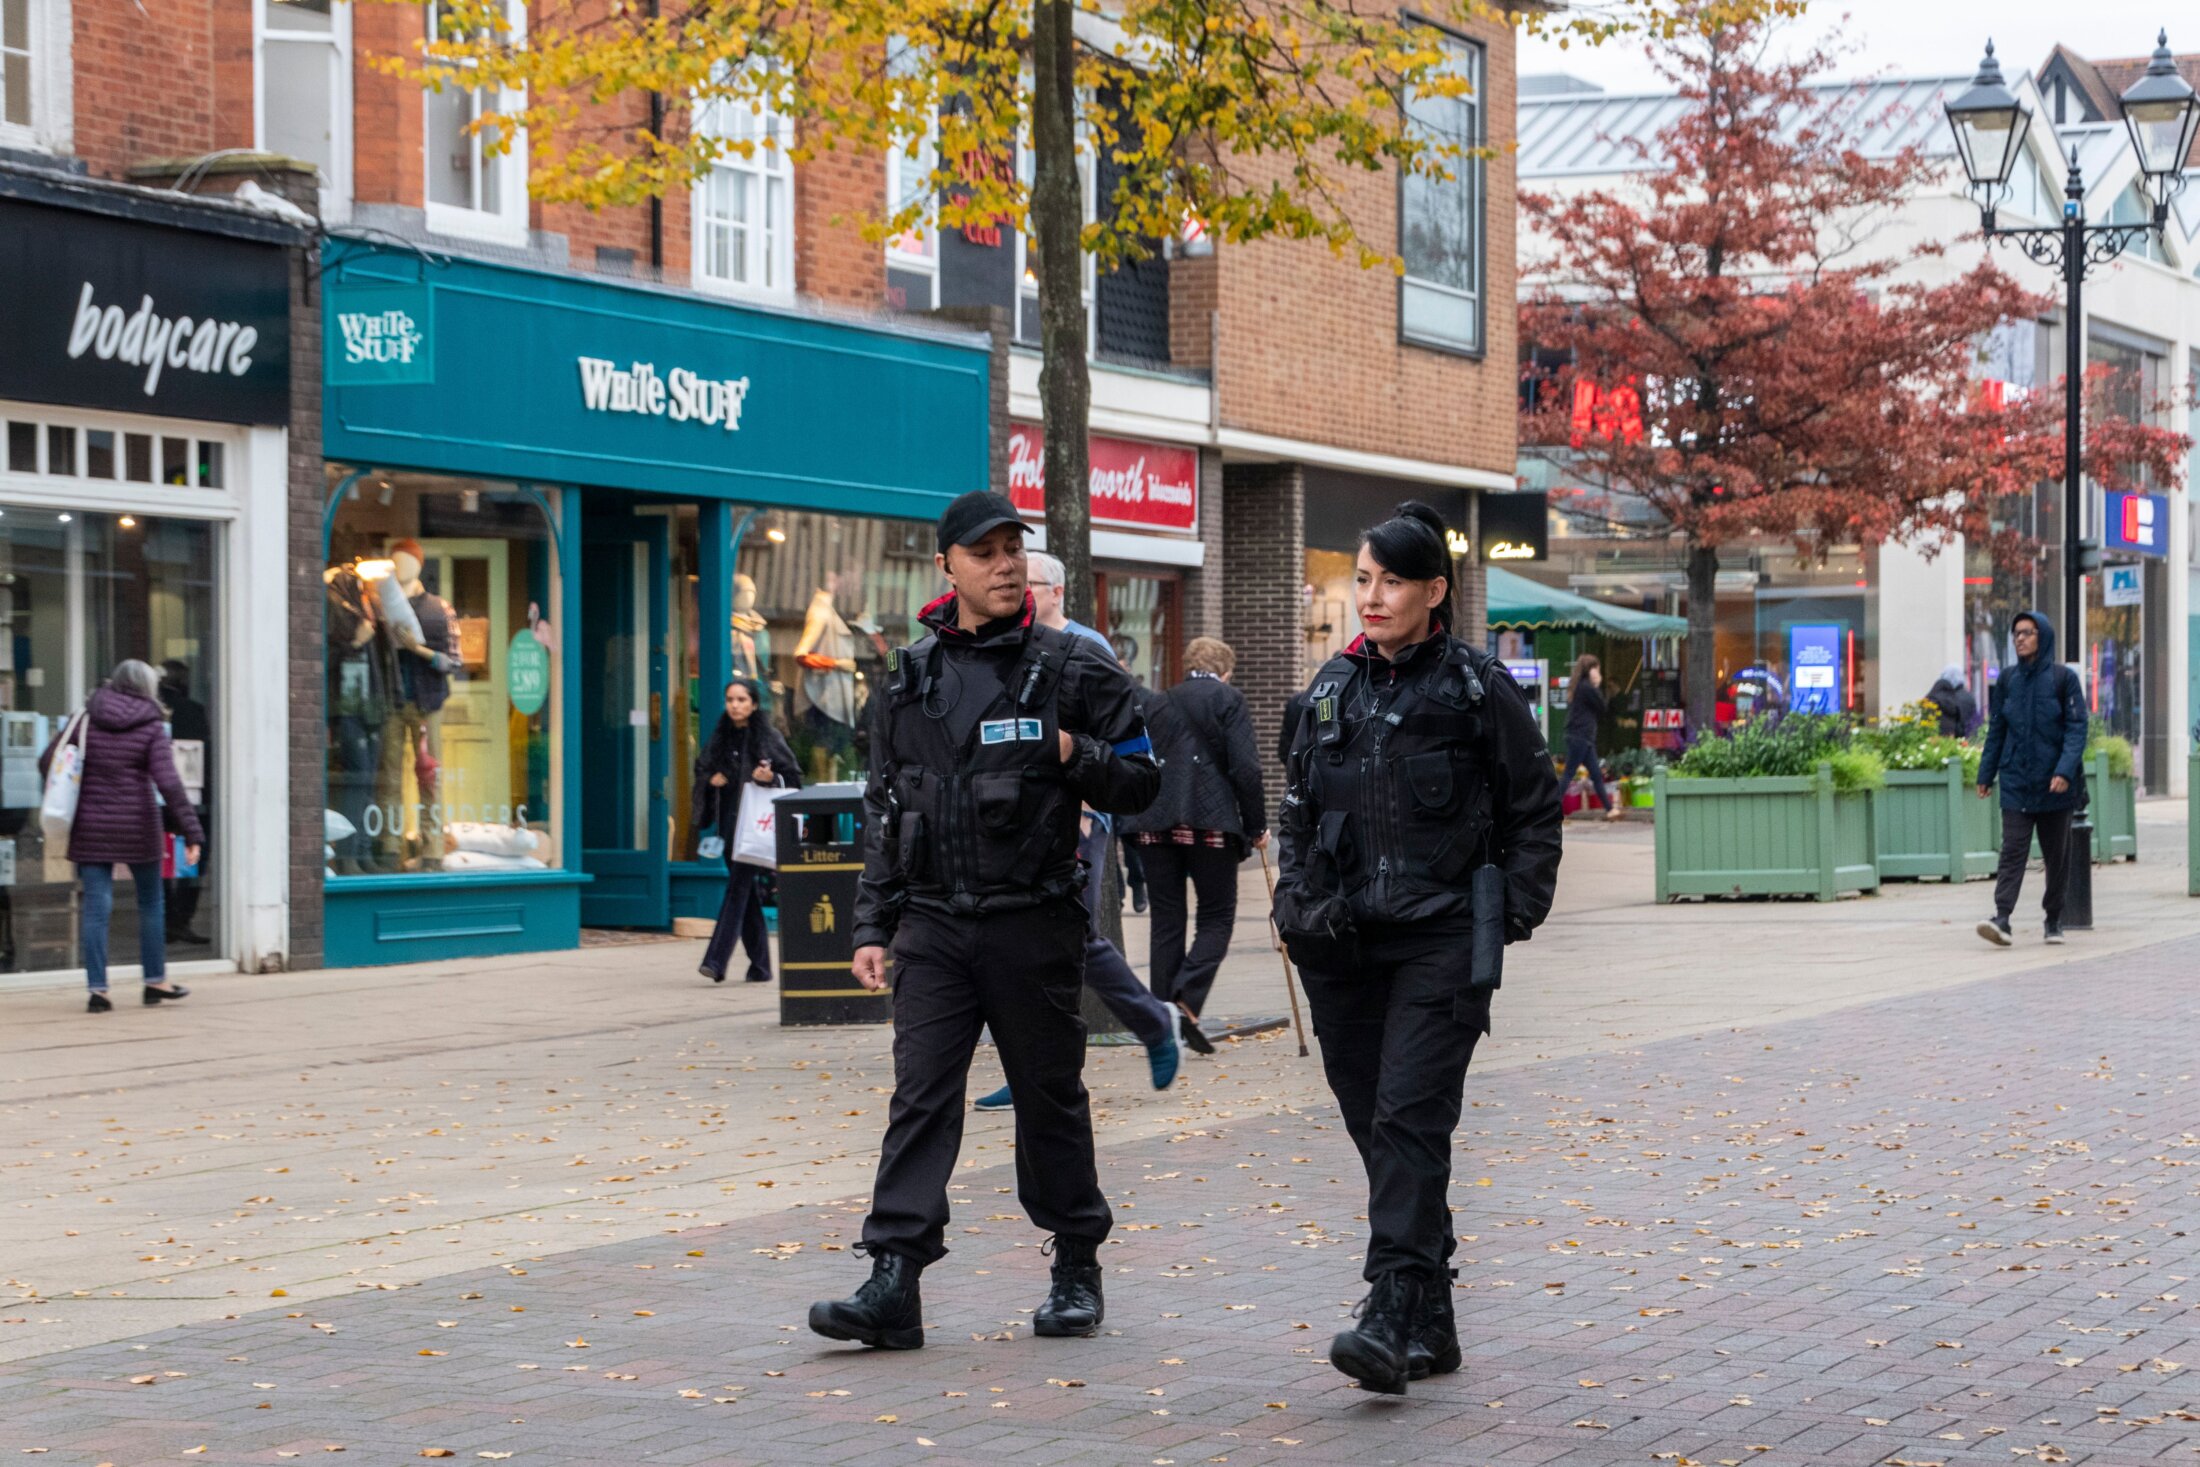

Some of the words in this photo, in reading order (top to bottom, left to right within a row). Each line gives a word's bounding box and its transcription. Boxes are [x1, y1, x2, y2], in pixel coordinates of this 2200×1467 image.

[67, 280, 258, 397] bodycare
[363, 804, 528, 837] OUTSIDERS
[803, 849, 841, 863] Litter
